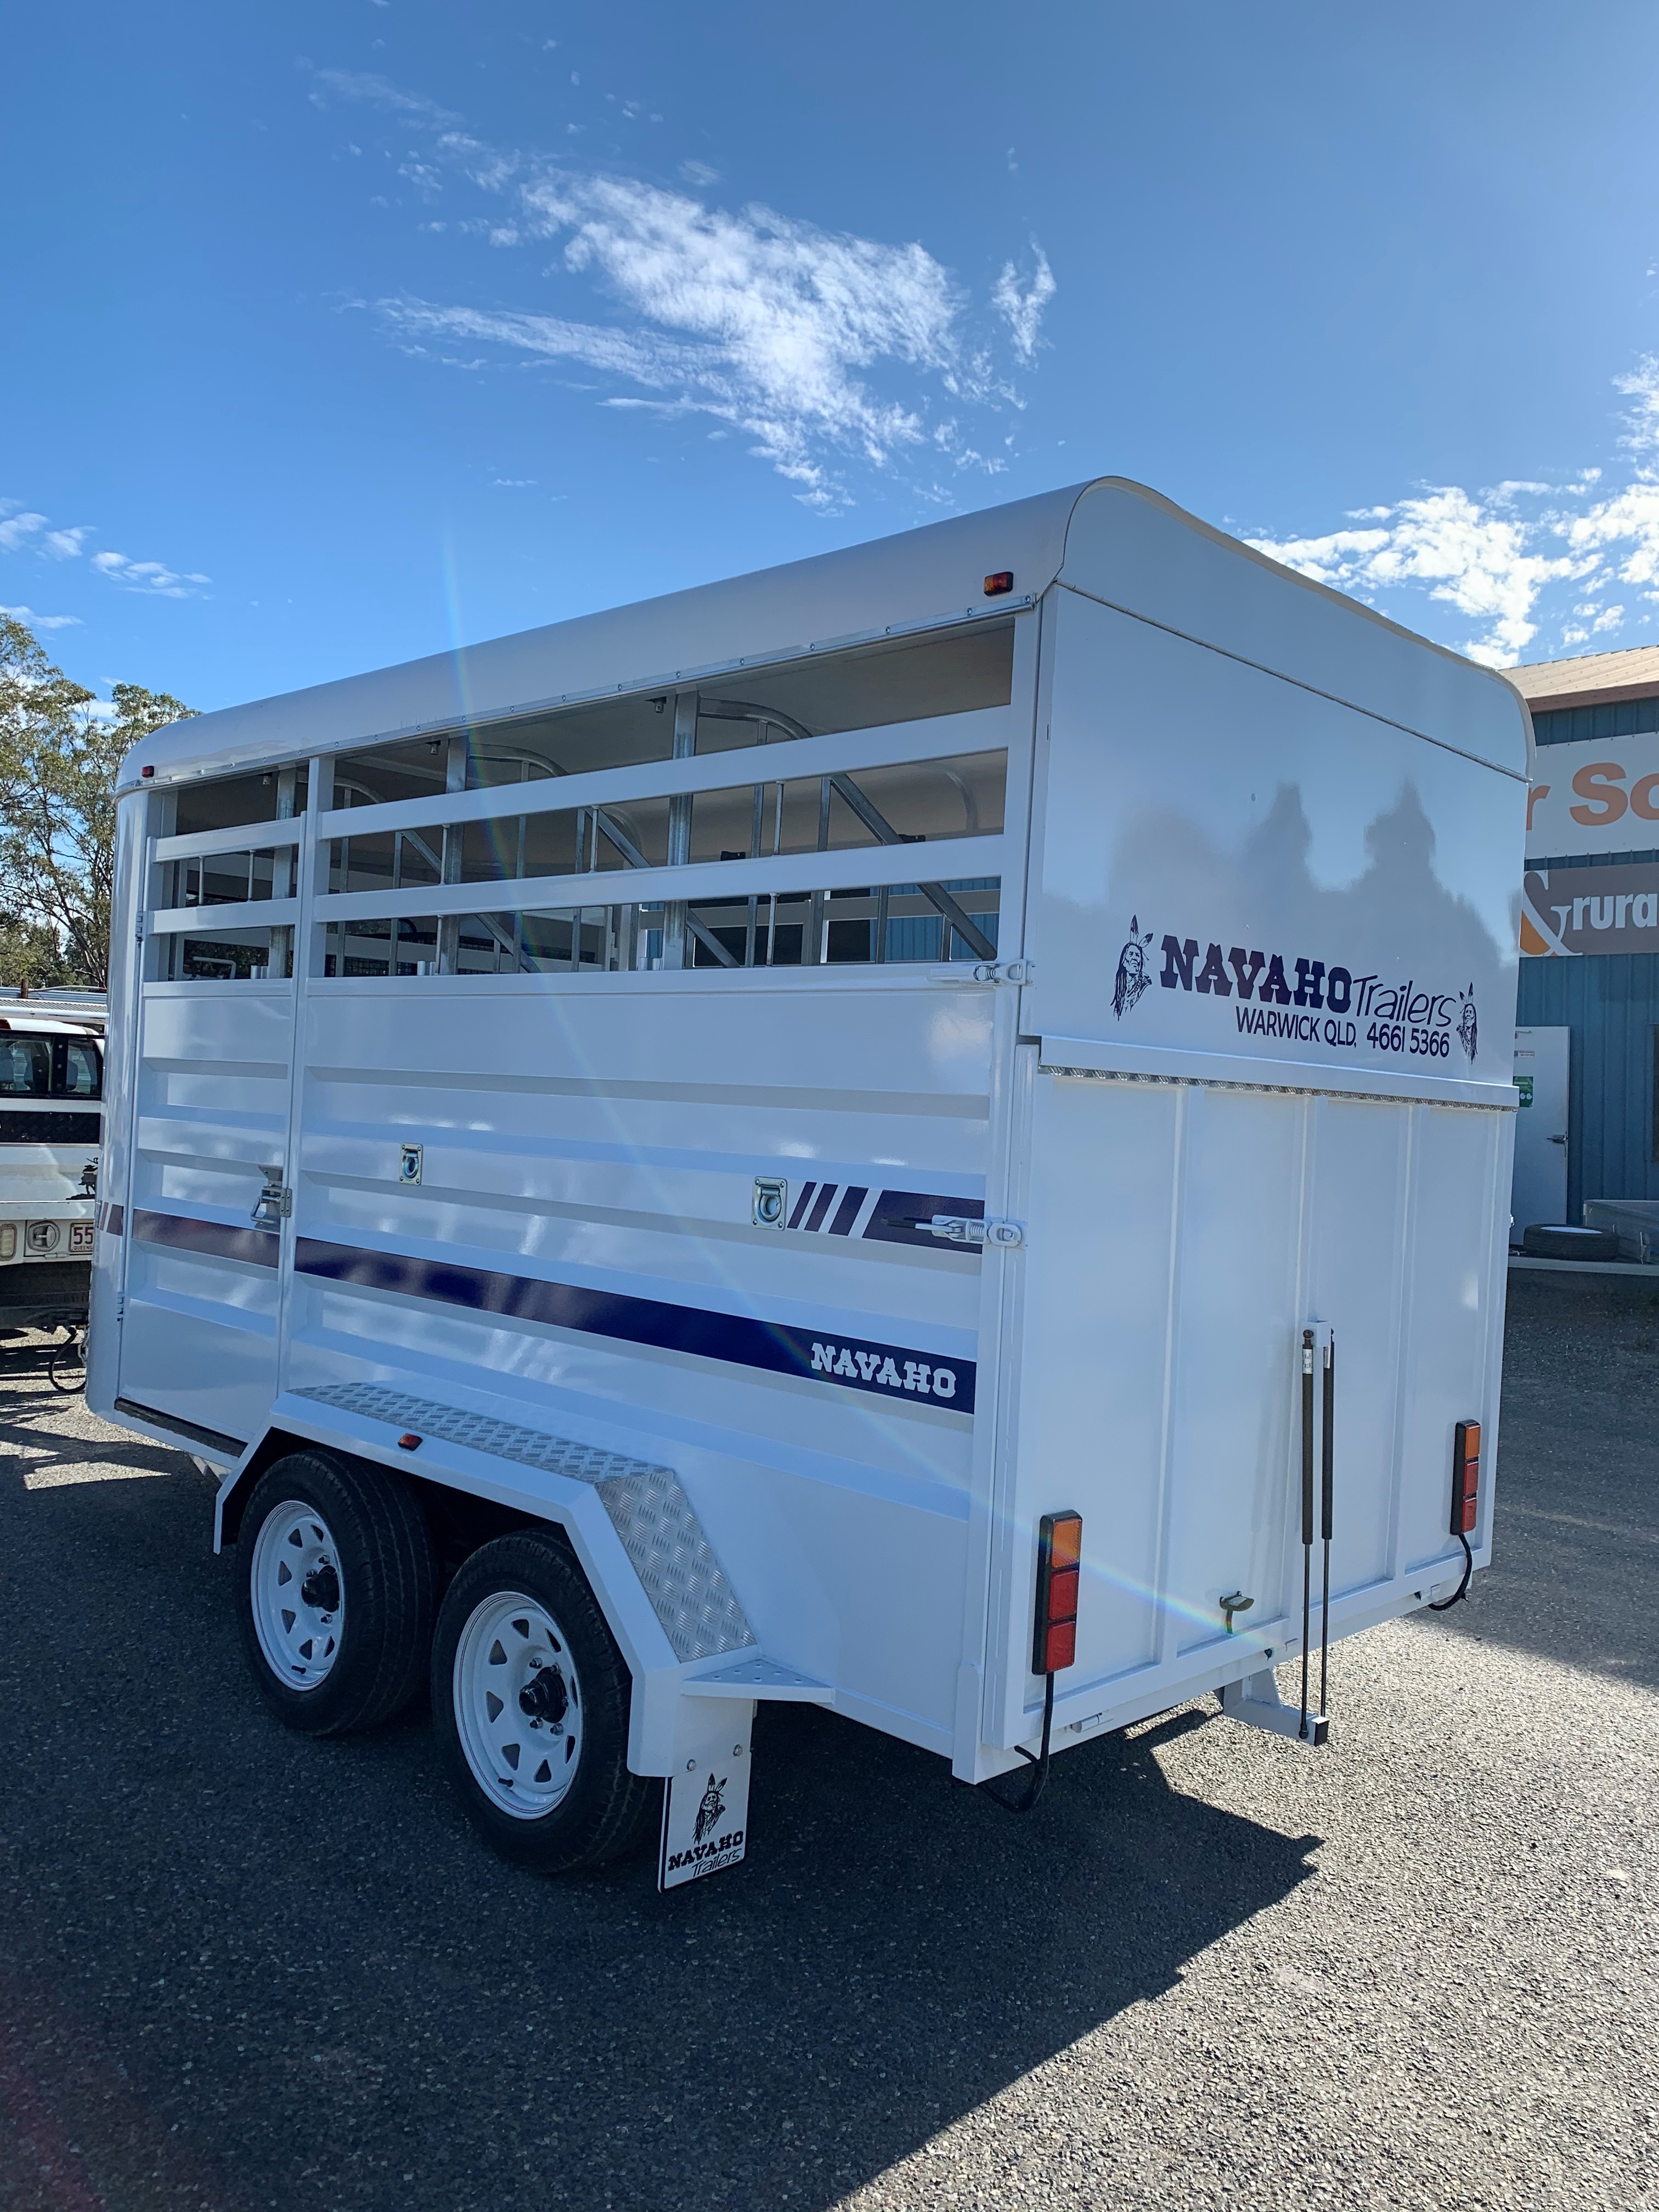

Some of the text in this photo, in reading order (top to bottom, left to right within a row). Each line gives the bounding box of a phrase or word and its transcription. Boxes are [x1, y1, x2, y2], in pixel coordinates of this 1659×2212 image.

[1159, 934, 1457, 1027] NAVAHO Trailers
[1235, 1006, 1321, 1042] WARWICK
[1367, 1022, 1406, 1052] 4661
[1409, 1028, 1449, 1058] 5366
[811, 1342, 956, 1398] NAVAHO
[668, 1831, 743, 1871] NAVAHO
[692, 1848, 742, 1877] Trailers
